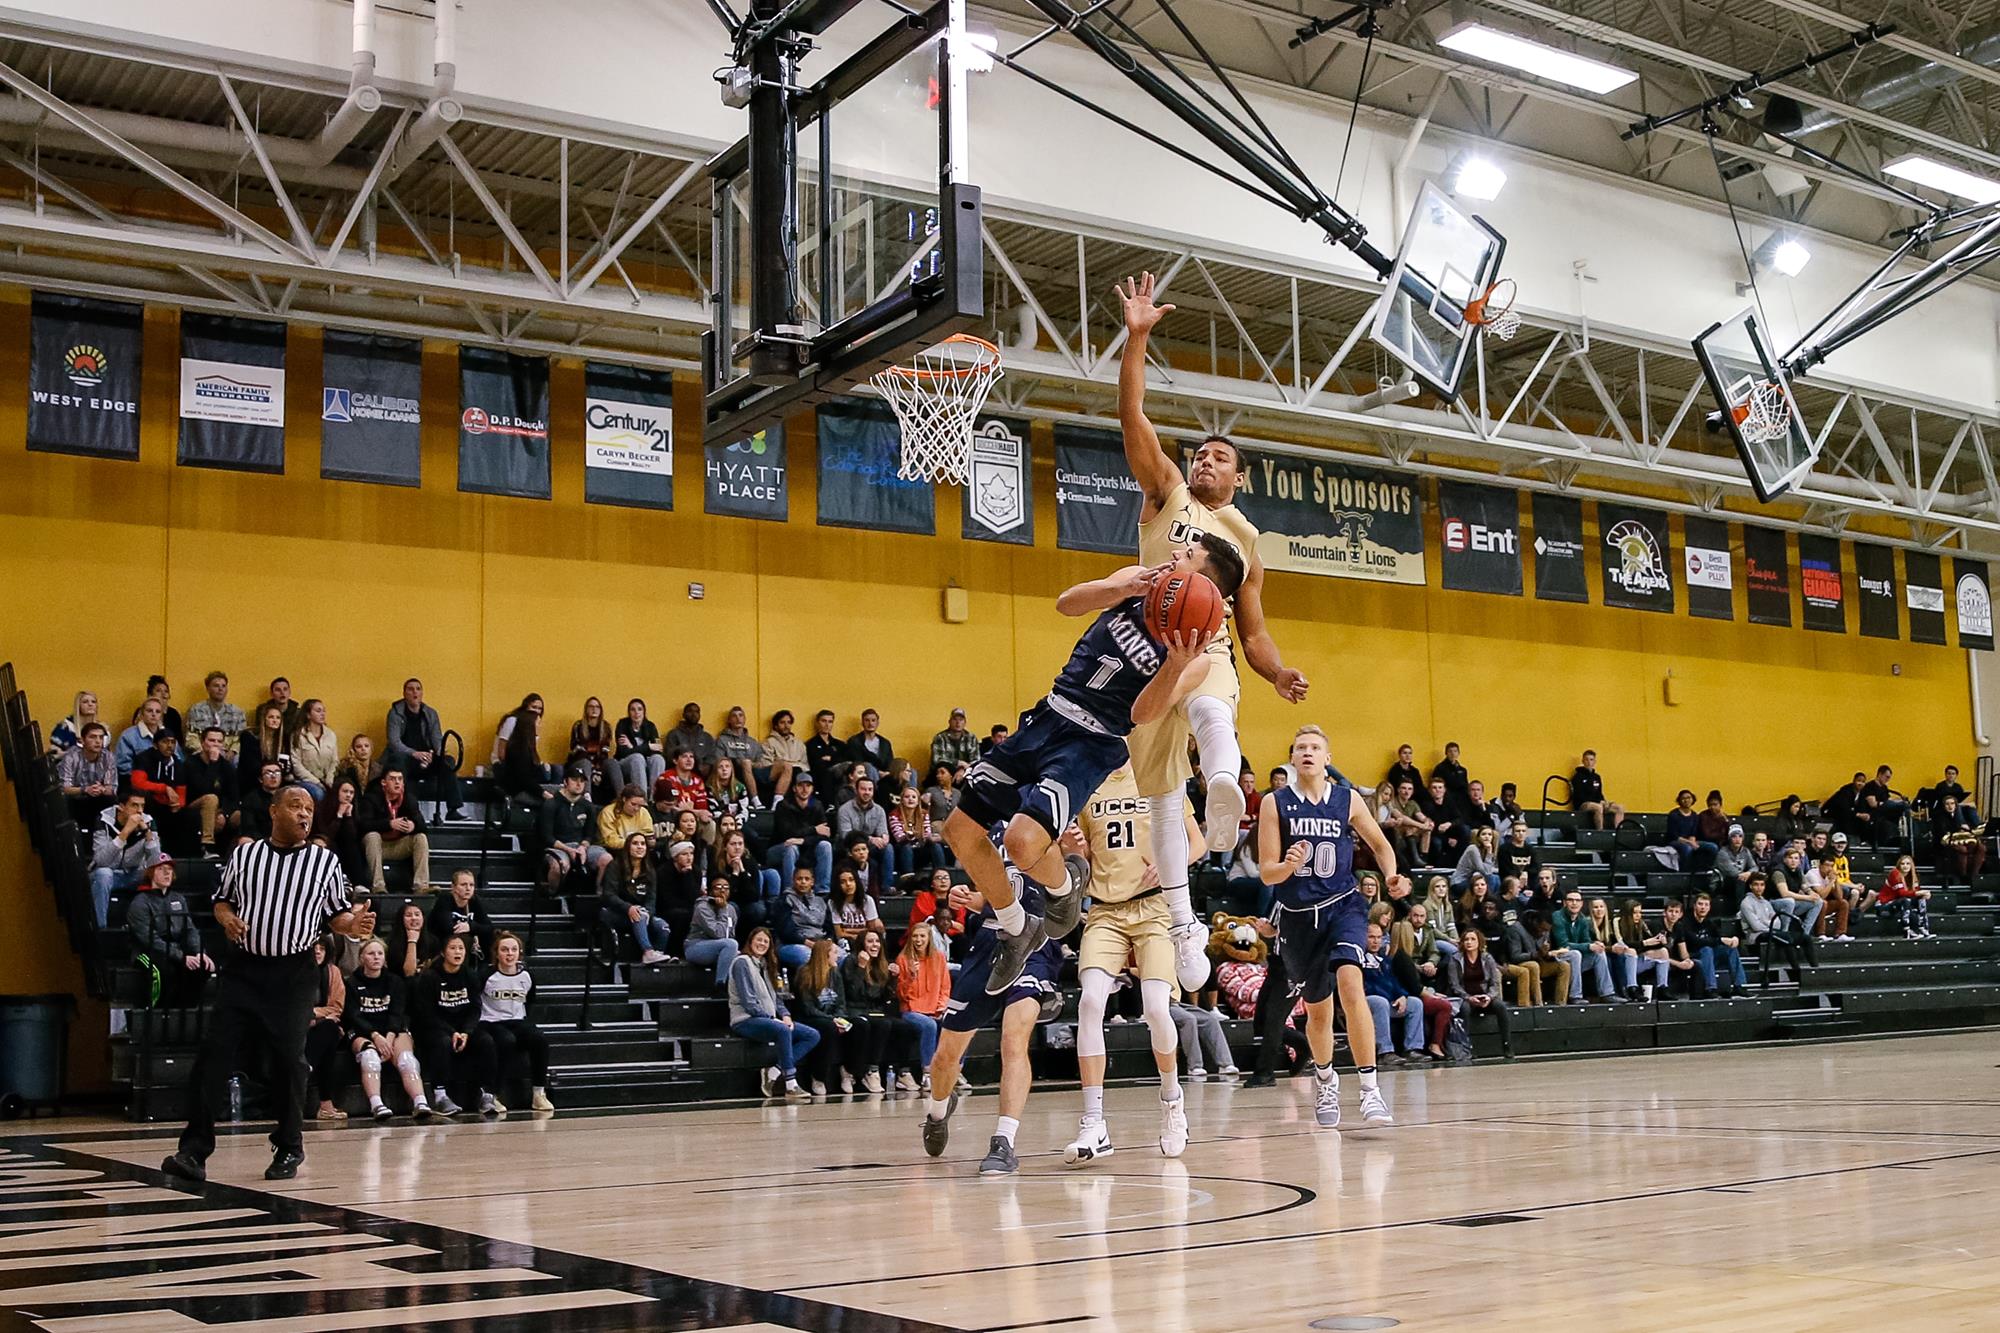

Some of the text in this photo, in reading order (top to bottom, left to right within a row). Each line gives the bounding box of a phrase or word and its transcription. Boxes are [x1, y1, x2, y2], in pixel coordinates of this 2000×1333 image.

[196, 382, 270, 396] AMERICAN FAMILY
[32, 391, 136, 413] WEST EDGE
[588, 404, 669, 452] Century 21
[597, 448, 661, 462] CARYN BECKER
[707, 460, 784, 484] HYATT
[1056, 468, 1091, 486] Centura
[1091, 473, 1119, 492] Sports
[719, 482, 777, 500] PLACE
[1262, 458, 1303, 501] You
[1313, 465, 1411, 515] Sponsors
[1470, 524, 1515, 554] Ent
[1289, 541, 1396, 567] Mountain Lions
[1803, 578, 1841, 600] GUARD
[1160, 577, 1184, 629] Wilson
[1106, 612, 1160, 677] MINES
[1086, 654, 1124, 690] 1
[1091, 797, 1151, 818] UCCS
[1105, 819, 1136, 850] 21
[1289, 817, 1341, 838] MINES
[1293, 839, 1337, 879] 20
